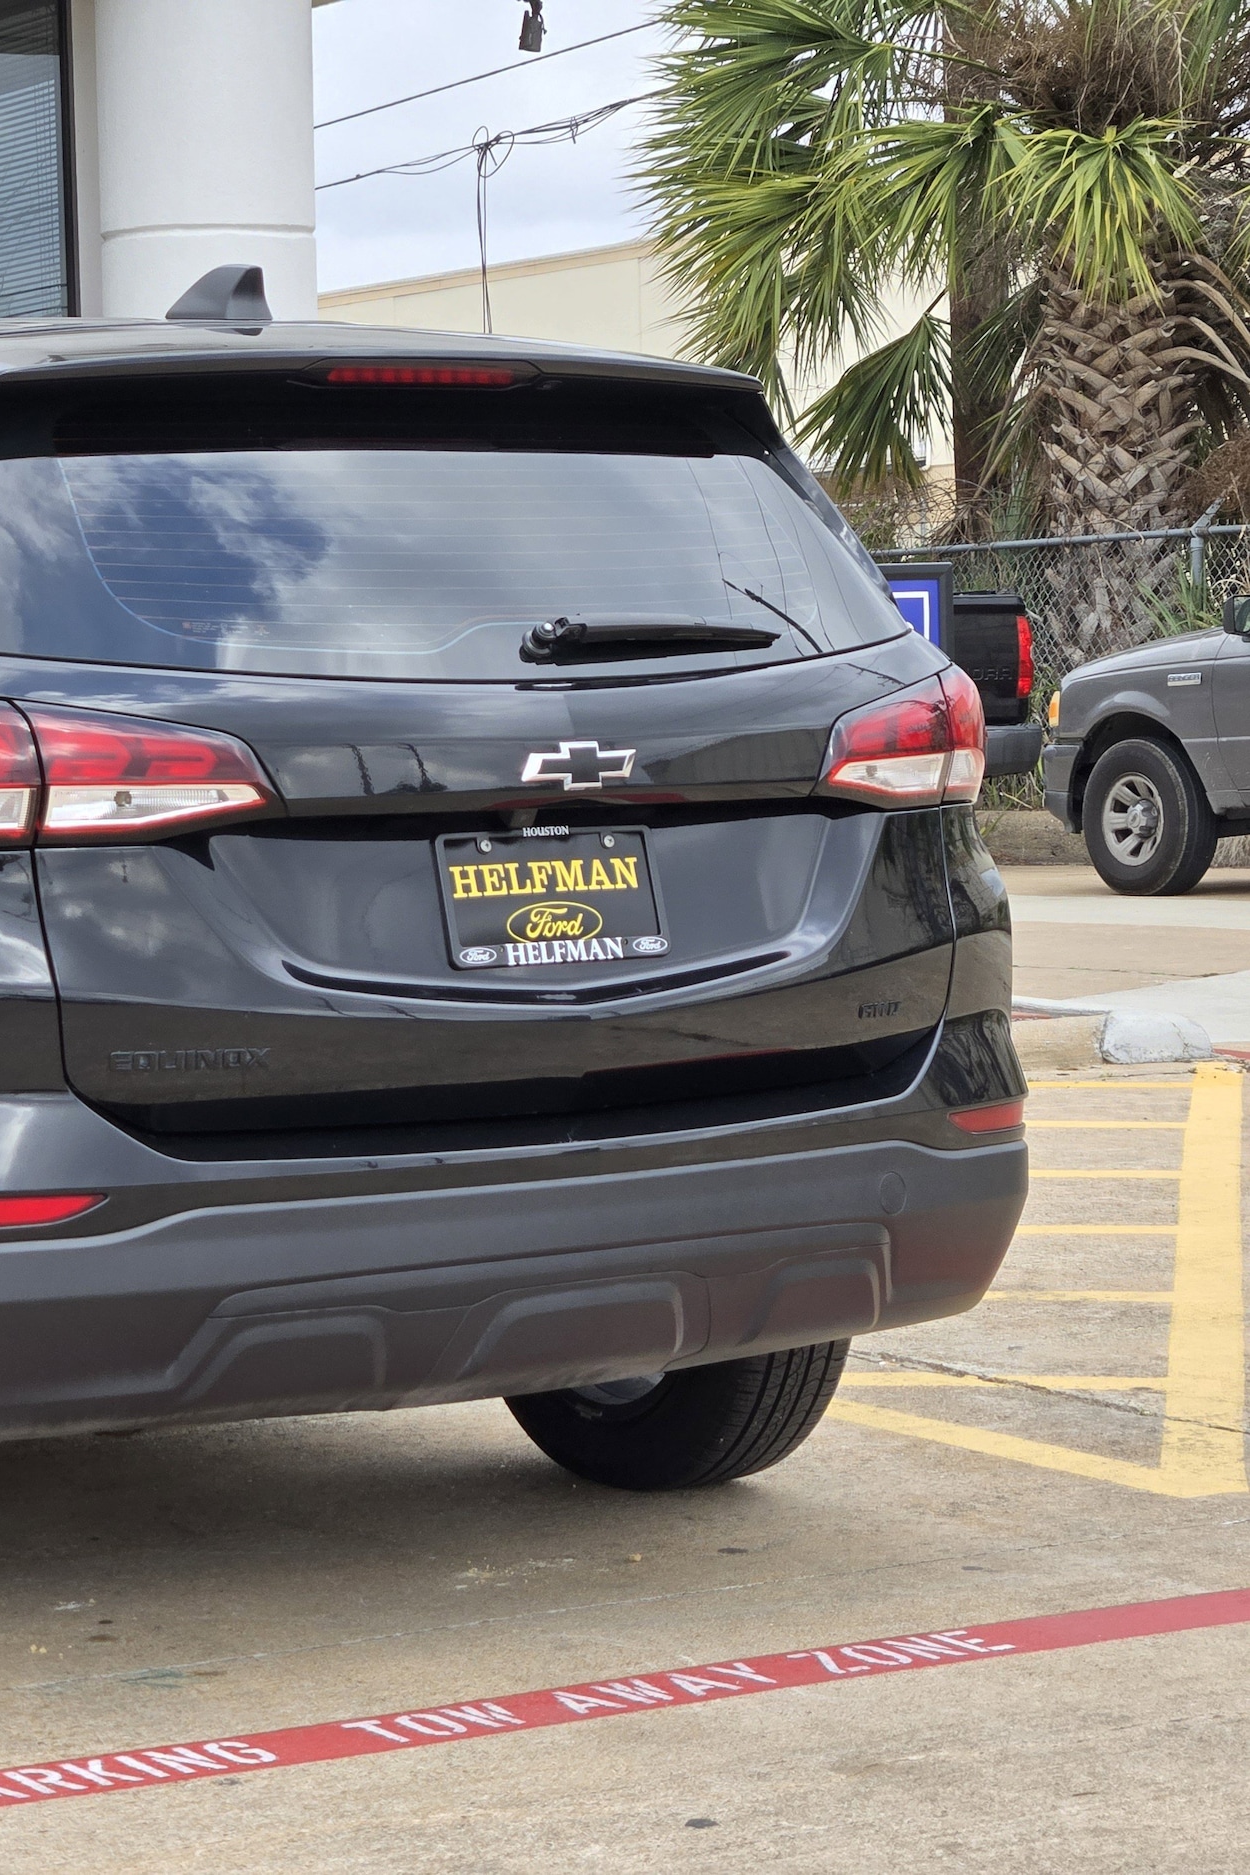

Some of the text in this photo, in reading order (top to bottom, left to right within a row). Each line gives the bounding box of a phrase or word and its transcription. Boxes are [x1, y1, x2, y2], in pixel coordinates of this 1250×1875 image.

[523, 826, 569, 837] HOUSTON
[449, 857, 639, 898] HELFMAN
[526, 907, 583, 939] Ford
[466, 948, 490, 962] Ford
[505, 937, 624, 966] HELFMAN
[639, 938, 662, 951] Ford
[110, 1047, 271, 1071] EQUINOX
[341, 1702, 527, 1743] TOW
[552, 1662, 777, 1714] AWAY
[787, 1630, 1017, 1674] ZONE
